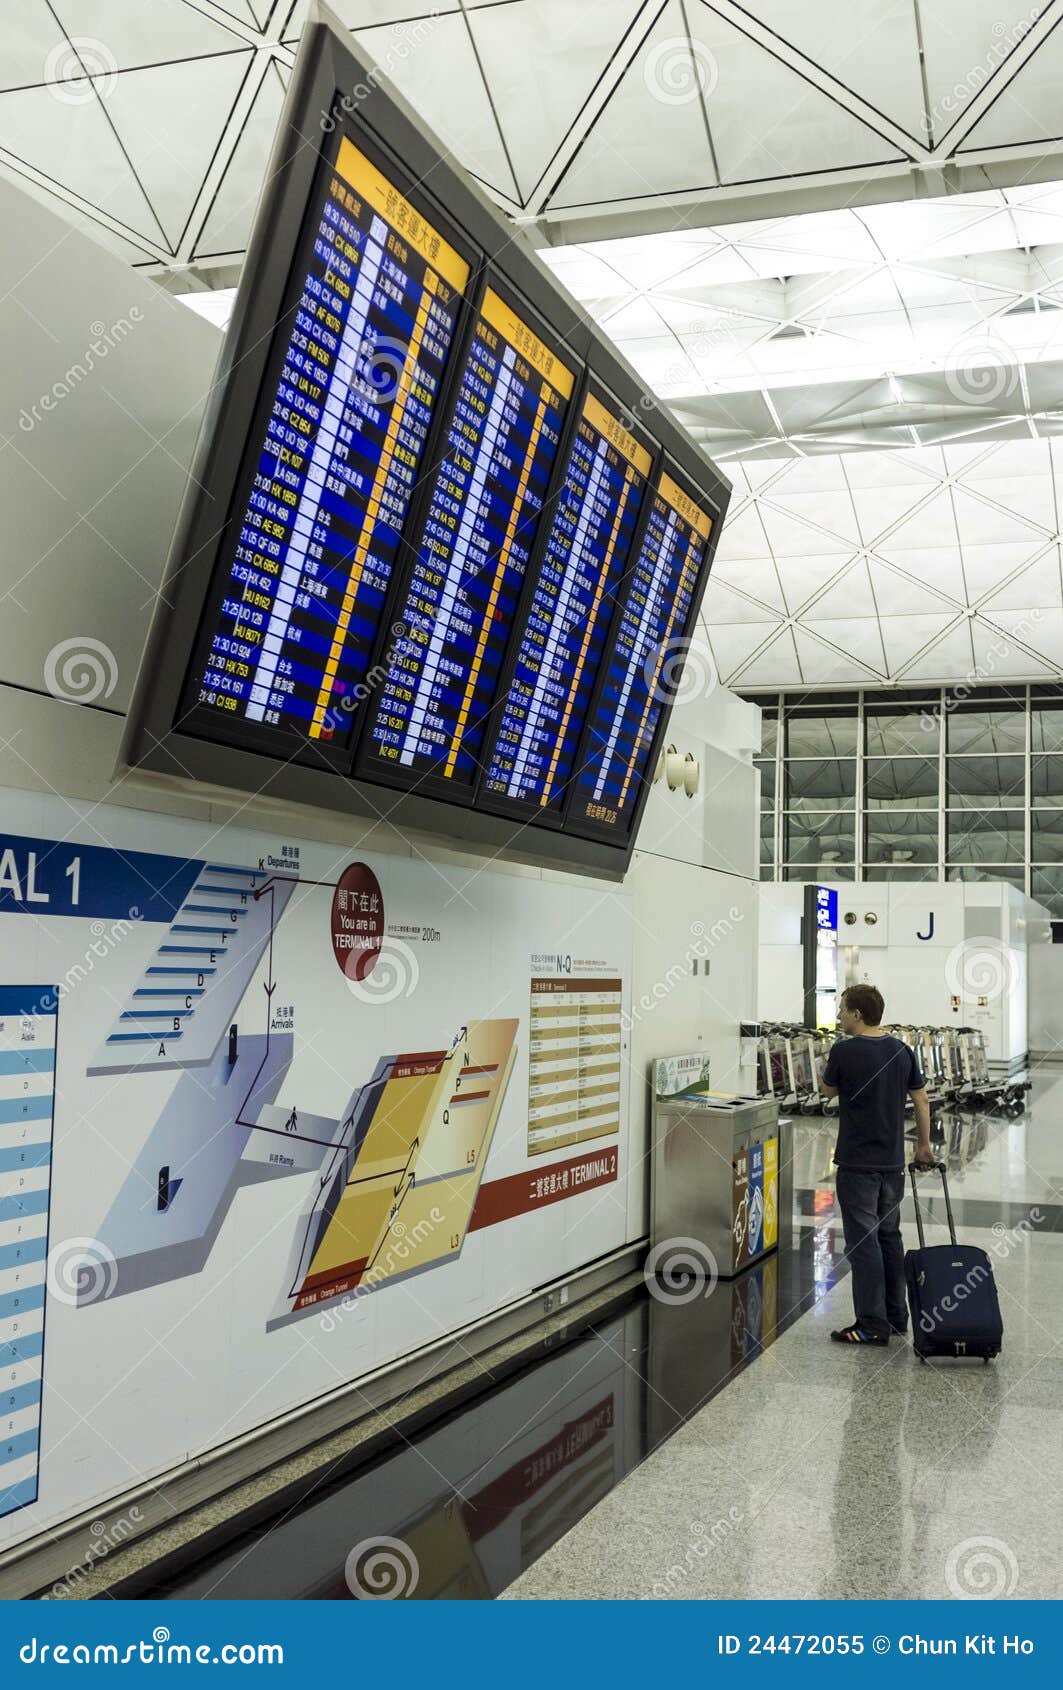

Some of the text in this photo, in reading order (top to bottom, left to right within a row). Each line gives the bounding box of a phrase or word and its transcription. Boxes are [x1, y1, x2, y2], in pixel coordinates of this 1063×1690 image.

[375, 184, 441, 262] 一號客運大樓
[308, 382, 321, 400] 117
[259, 858, 264, 870] K
[267, 855, 299, 869] Departures
[0, 849, 81, 905] AL 1
[250, 874, 255, 887] J
[240, 892, 247, 904] H
[339, 890, 379, 913] 閣下在此
[230, 911, 237, 922] G
[340, 915, 354, 929] You
[356, 919, 368, 930] are
[369, 917, 376, 931] in
[916, 912, 934, 940] J
[222, 932, 227, 943] F
[422, 928, 440, 941] 200m
[335, 934, 374, 949] TERMINAL
[210, 952, 216, 963] E
[198, 974, 204, 986] D
[185, 996, 192, 1009] C
[173, 1018, 180, 1030] B
[271, 1018, 294, 1029] Arrivals
[158, 1043, 166, 1056] A
[464, 1053, 469, 1066] N
[456, 1078, 461, 1092] P
[443, 1109, 449, 1124] Q
[466, 1150, 475, 1164] L5
[529, 1155, 615, 1199] 二號客運大樓 TERMINAL 2
[450, 1233, 459, 1249] L3
